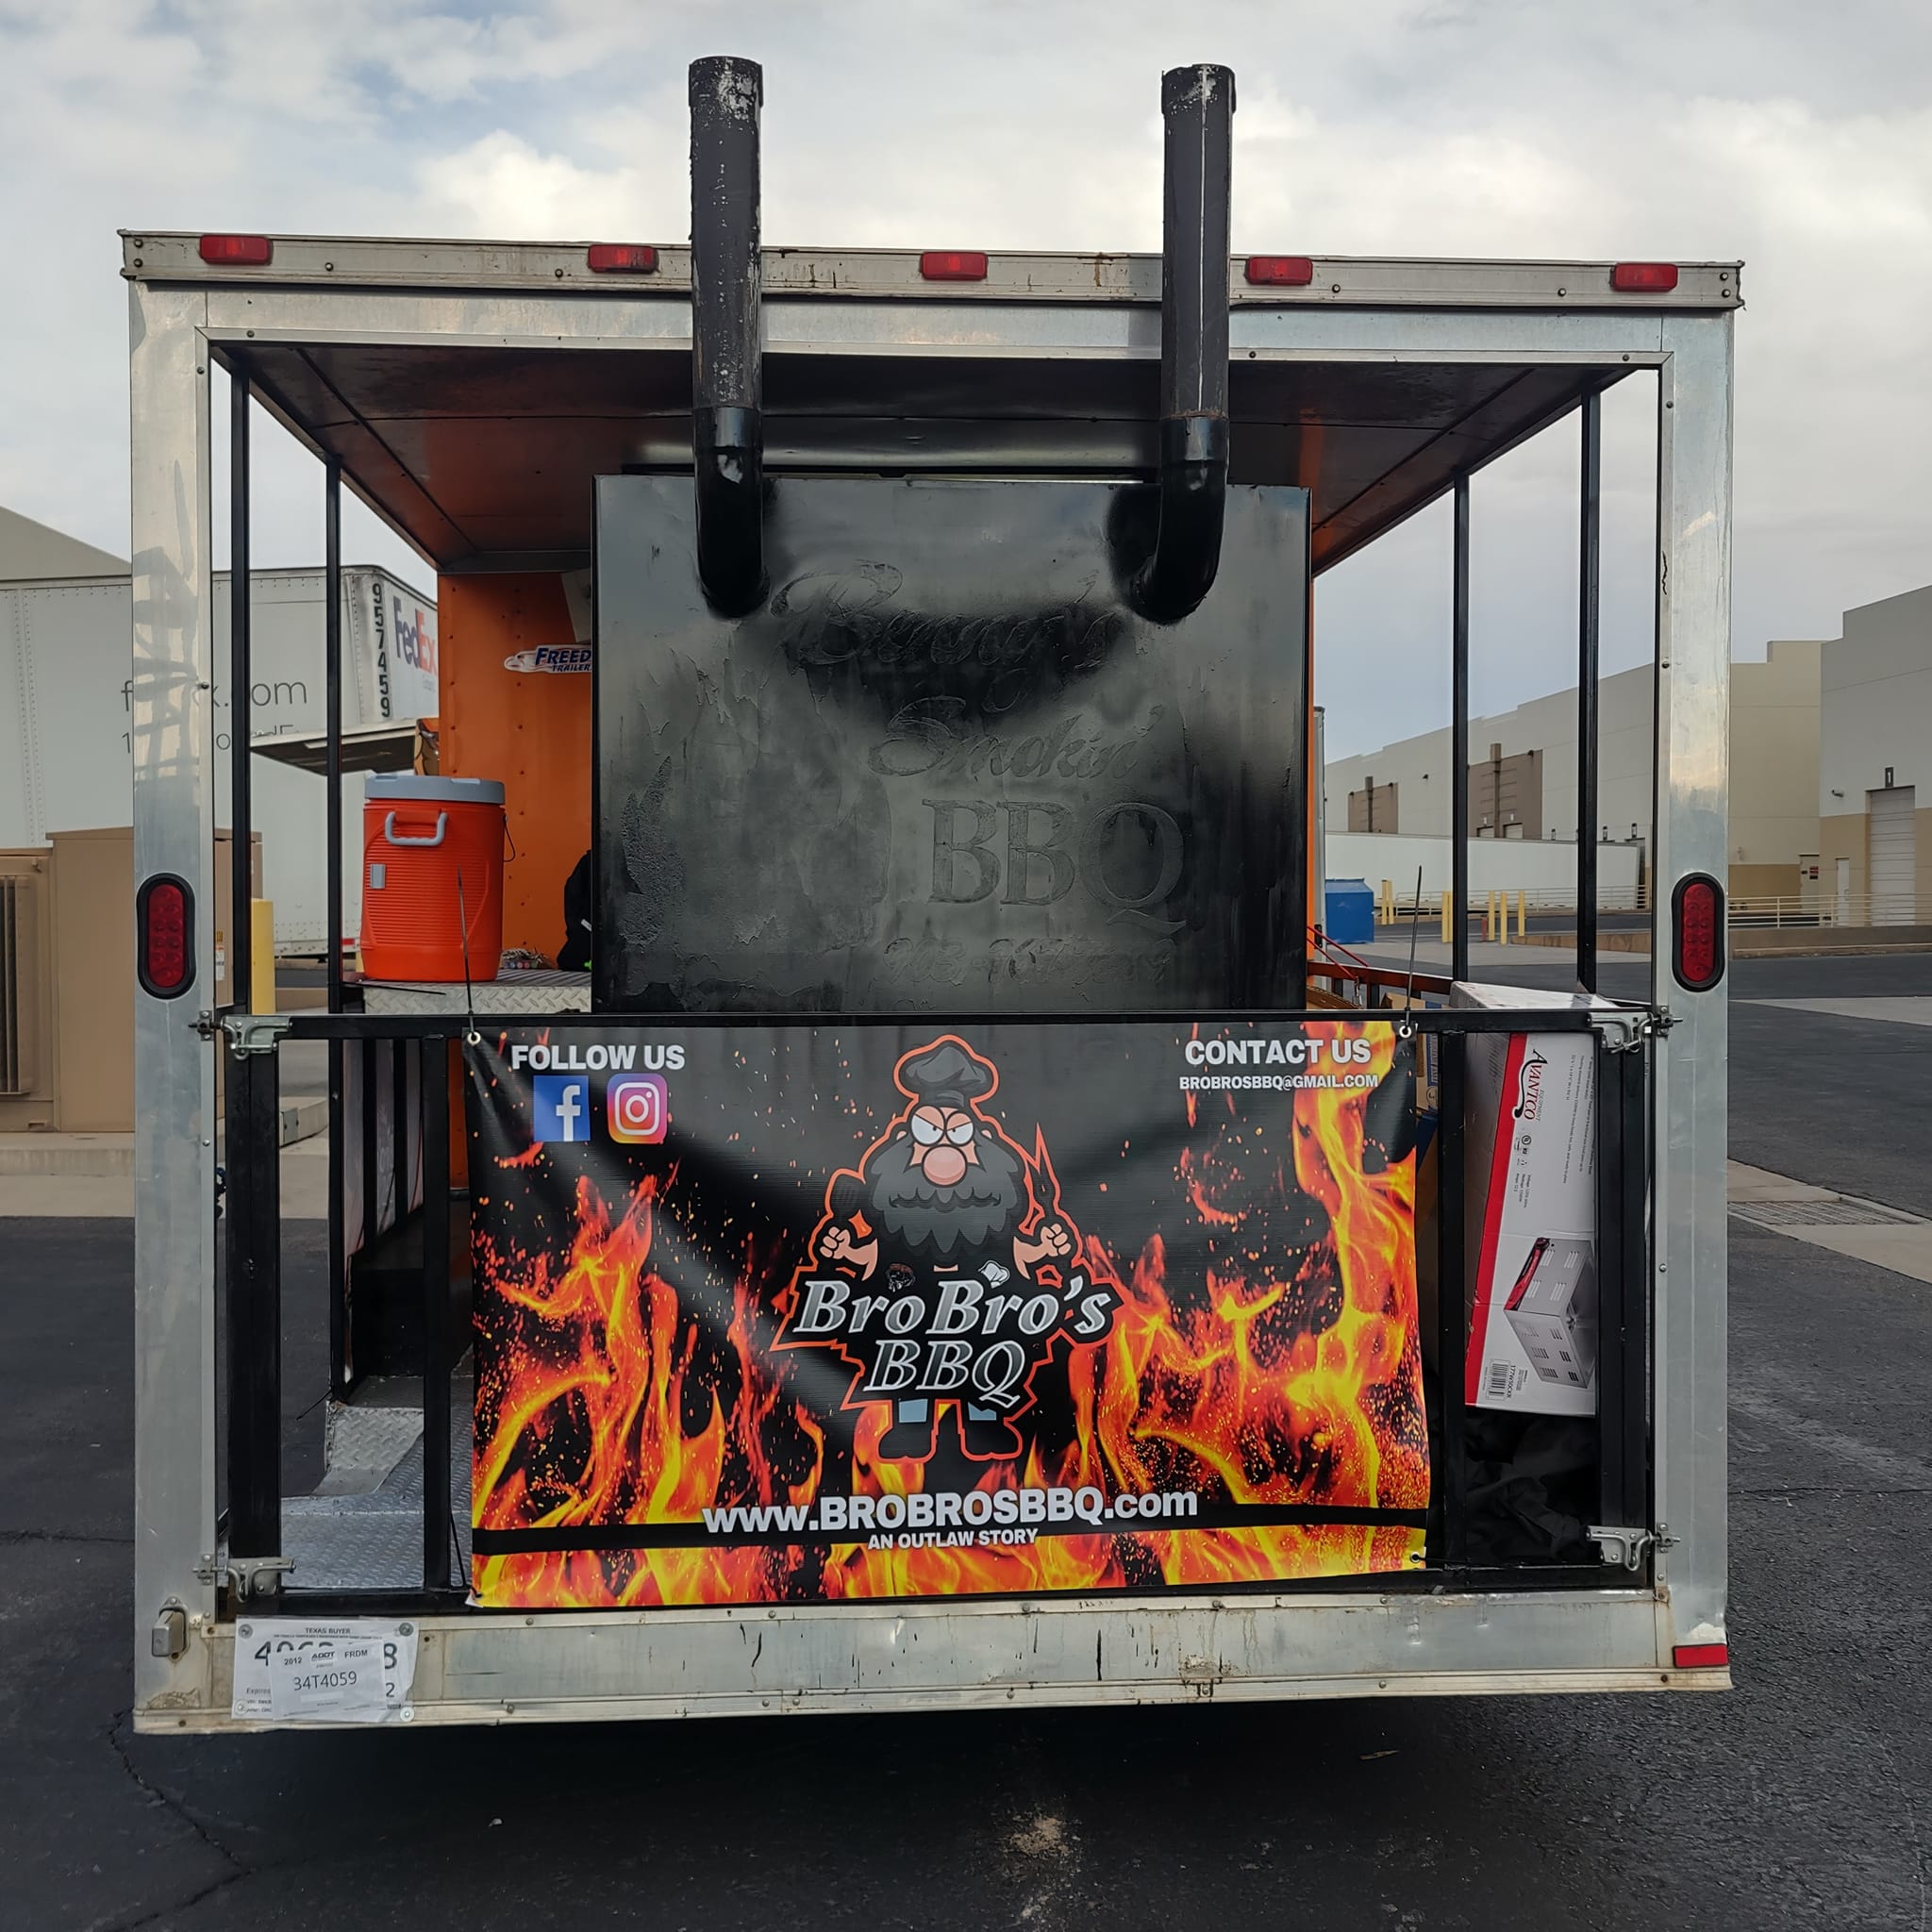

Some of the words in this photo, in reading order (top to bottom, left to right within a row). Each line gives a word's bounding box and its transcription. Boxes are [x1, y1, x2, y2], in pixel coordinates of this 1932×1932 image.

[392, 595, 438, 676] FedEx
[372, 583, 391, 718] 957459
[921, 798, 1187, 937] BBQ
[512, 1045, 636, 1070] FOLLOW
[644, 1045, 685, 1070] US
[1185, 1039, 1323, 1065] CONTACT
[1331, 1039, 1371, 1063] US
[1179, 1074, 1380, 1091] BROBROSBBQ@GMAIL.COM
[863, 1340, 1025, 1408] BBQ
[703, 1487, 1198, 1533] www.BROBROSBBQ.com
[867, 1535, 893, 1550] AN
[899, 1532, 974, 1549] OUTLAW
[978, 1527, 1039, 1545] STORY
[284, 1657, 303, 1666] 2012
[344, 1649, 368, 1658] FRDM
[293, 1671, 358, 1690] 34T4059
